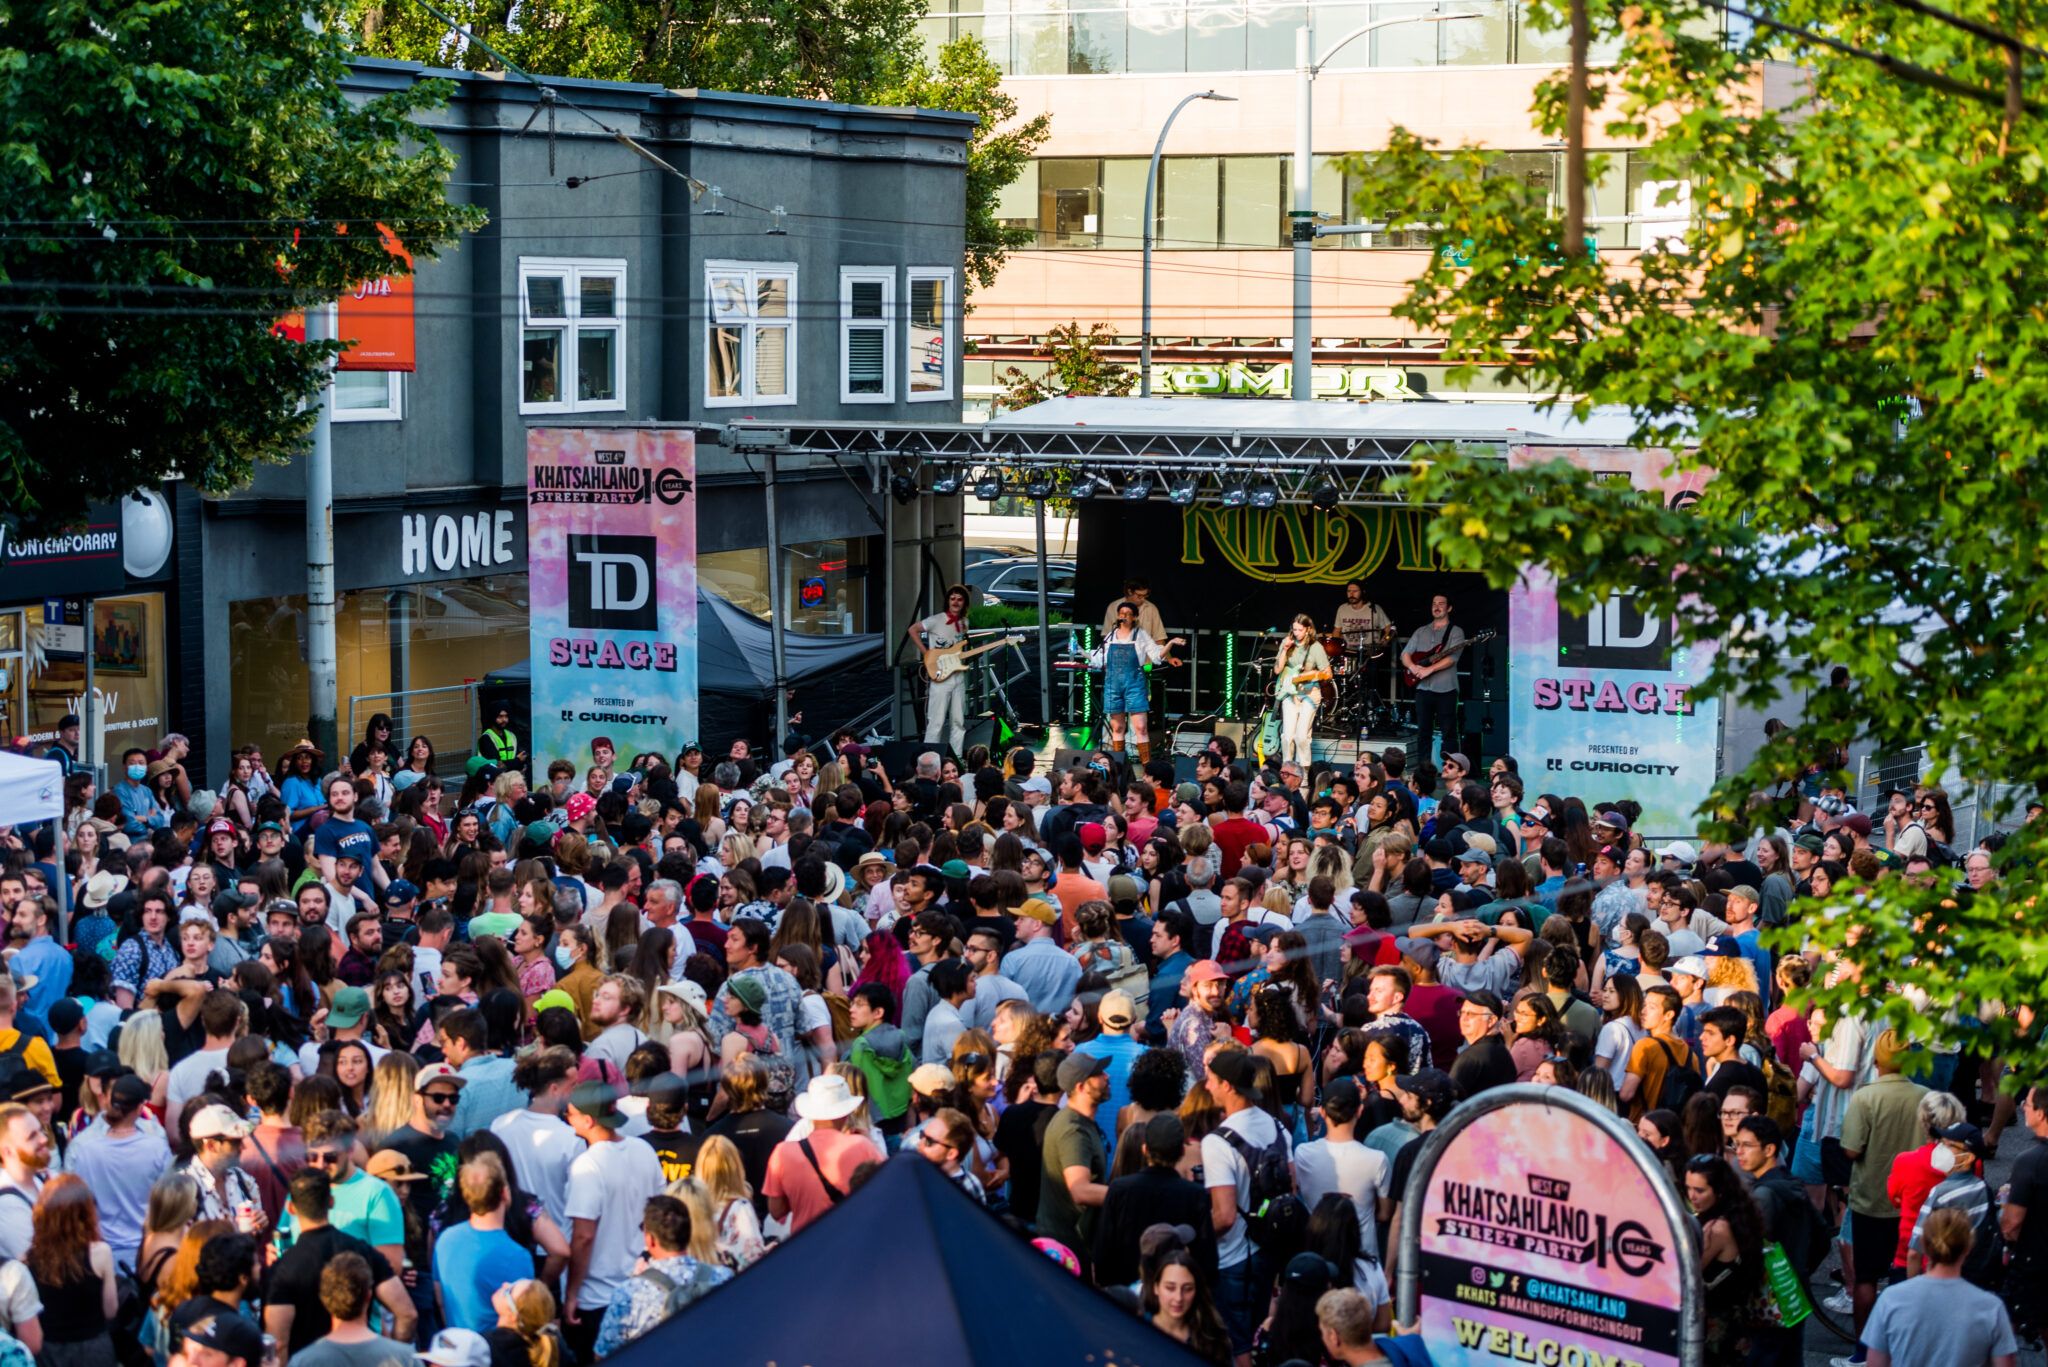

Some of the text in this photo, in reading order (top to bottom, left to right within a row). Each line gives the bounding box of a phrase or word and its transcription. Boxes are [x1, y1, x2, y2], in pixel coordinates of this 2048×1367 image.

[597, 452, 613, 463] WEST
[534, 466, 640, 490] KHATSAHLANO
[643, 467, 686, 506] 10
[537, 492, 636, 503] STREET PARTY
[8, 532, 117, 557] CONTEMPORARY
[402, 509, 514, 576] HOME
[576, 552, 650, 611] TD
[47, 601, 60, 621] T
[549, 637, 677, 672] STAGE
[66, 687, 119, 715] WW
[593, 698, 635, 708] PRESENTED BY
[1533, 677, 1695, 717] STAGE
[103, 720, 131, 732] URNITURE
[132, 719, 138, 728] &
[138, 717, 159, 728] DECOR
[579, 712, 668, 726] CURIOCITY
[1588, 745, 1639, 756] PRESENTED BY
[1570, 760, 1680, 776] CURIOCITY
[1530, 1177, 1552, 1194] WEST
[1443, 1180, 1589, 1240] KHATSAHLANO
[1445, 1220, 1585, 1263] STREET PARTY
[1595, 1213, 1655, 1277] 10
[1625, 1242, 1652, 1255] YEARS
[1526, 1278, 1627, 1319] @KHATSAHLANO
[1456, 1284, 1643, 1342] #KHATS #MAKINGUPFORMISSINGOUT
[1451, 1317, 1646, 1367] WELCOM
